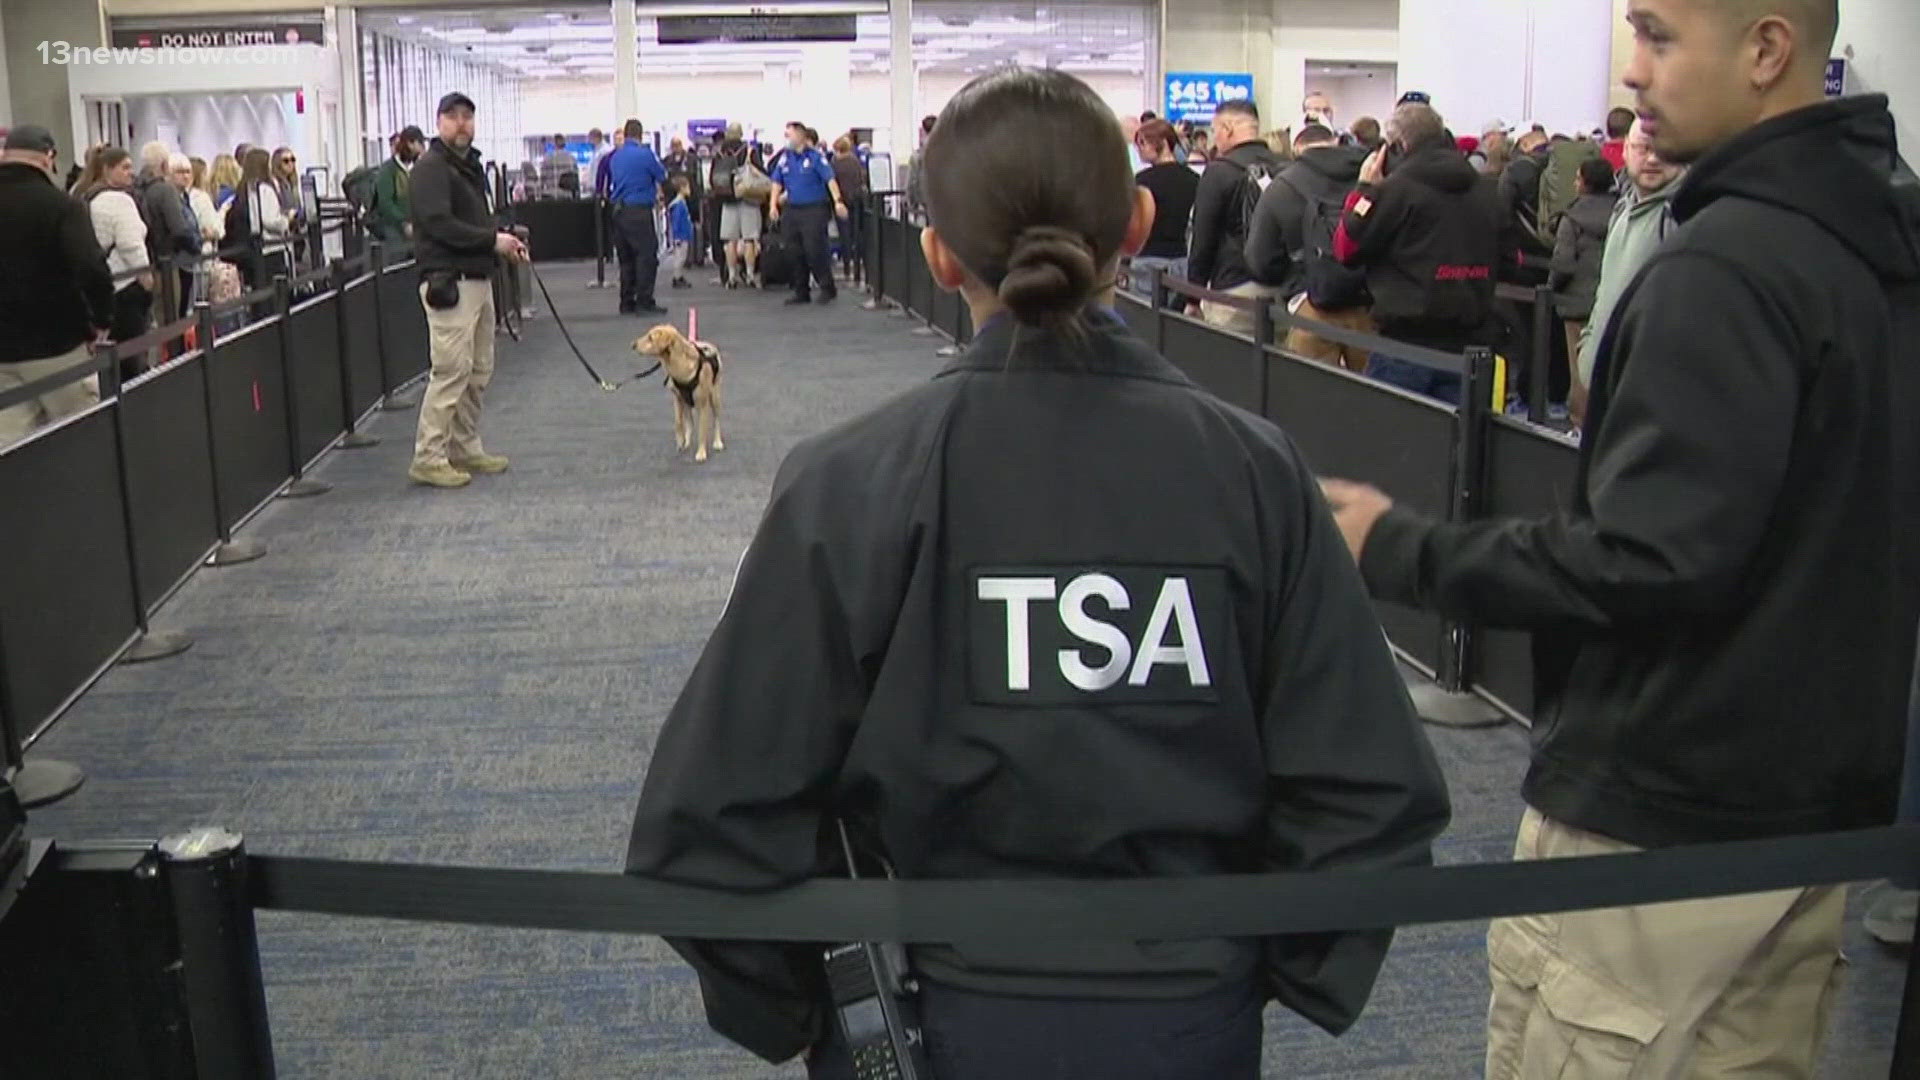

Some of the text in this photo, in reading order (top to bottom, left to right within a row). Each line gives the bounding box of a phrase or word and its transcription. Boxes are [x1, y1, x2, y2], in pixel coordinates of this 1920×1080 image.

[161, 30, 275, 48] DO NOT ENTER
[1169, 79, 1248, 103] $45 fee
[977, 572, 1211, 691] TSA
